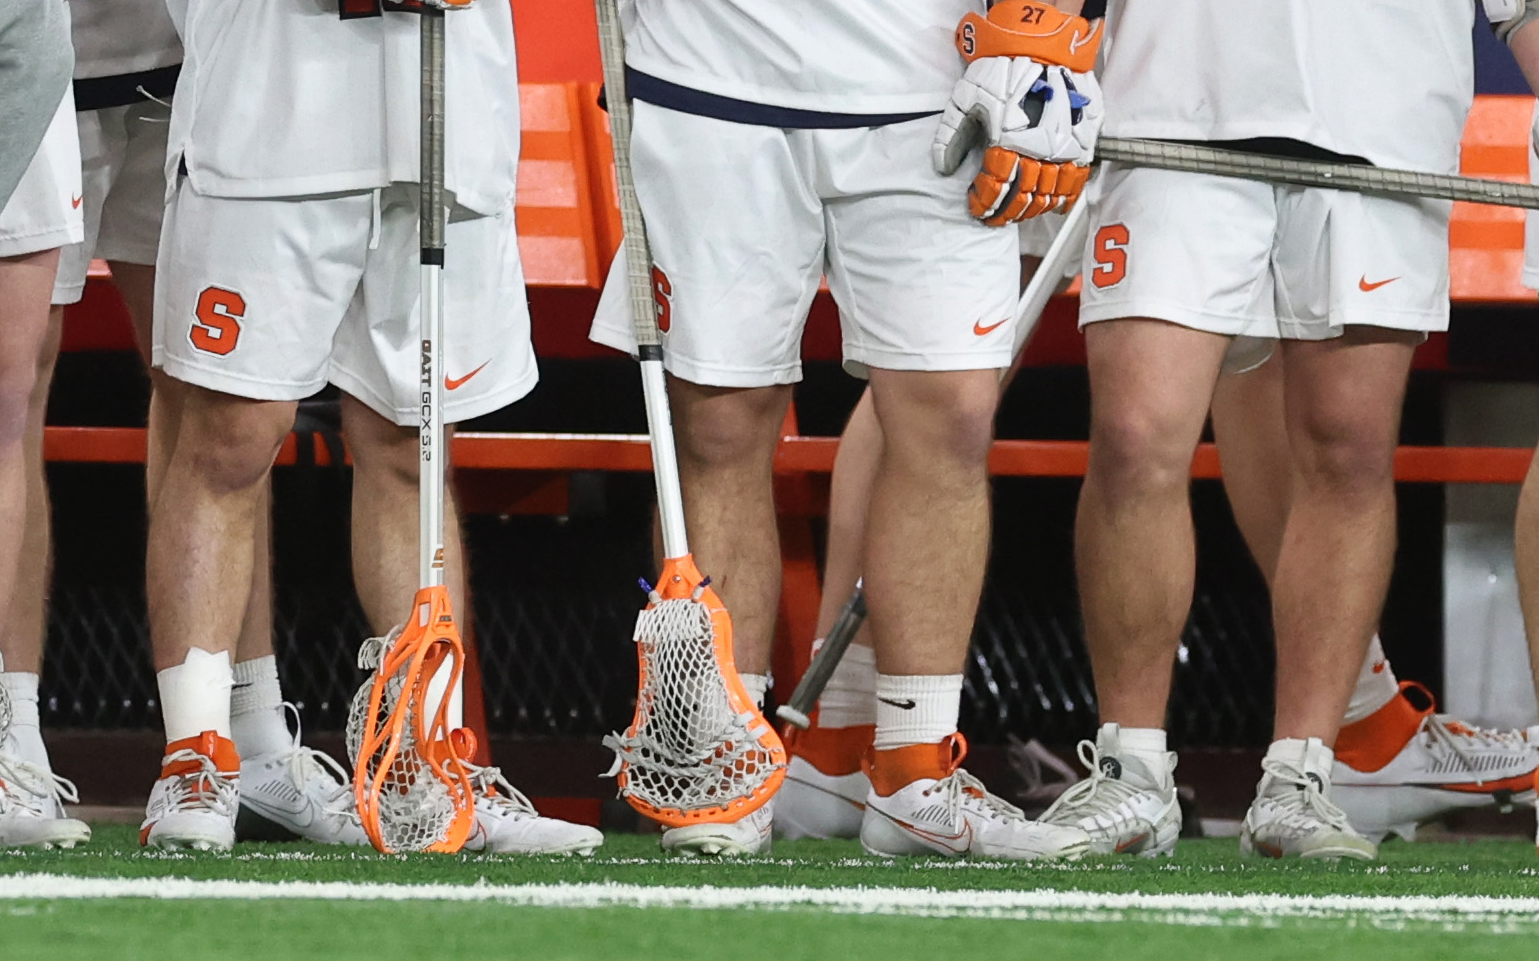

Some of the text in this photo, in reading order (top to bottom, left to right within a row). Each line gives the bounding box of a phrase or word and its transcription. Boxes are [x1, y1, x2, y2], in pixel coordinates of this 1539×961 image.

[1019, 5, 1046, 25] 27
[962, 21, 976, 56] S
[1091, 223, 1131, 290] S
[189, 284, 247, 357] S
[421, 339, 432, 388] GAIT
[421, 391, 432, 431] GCX
